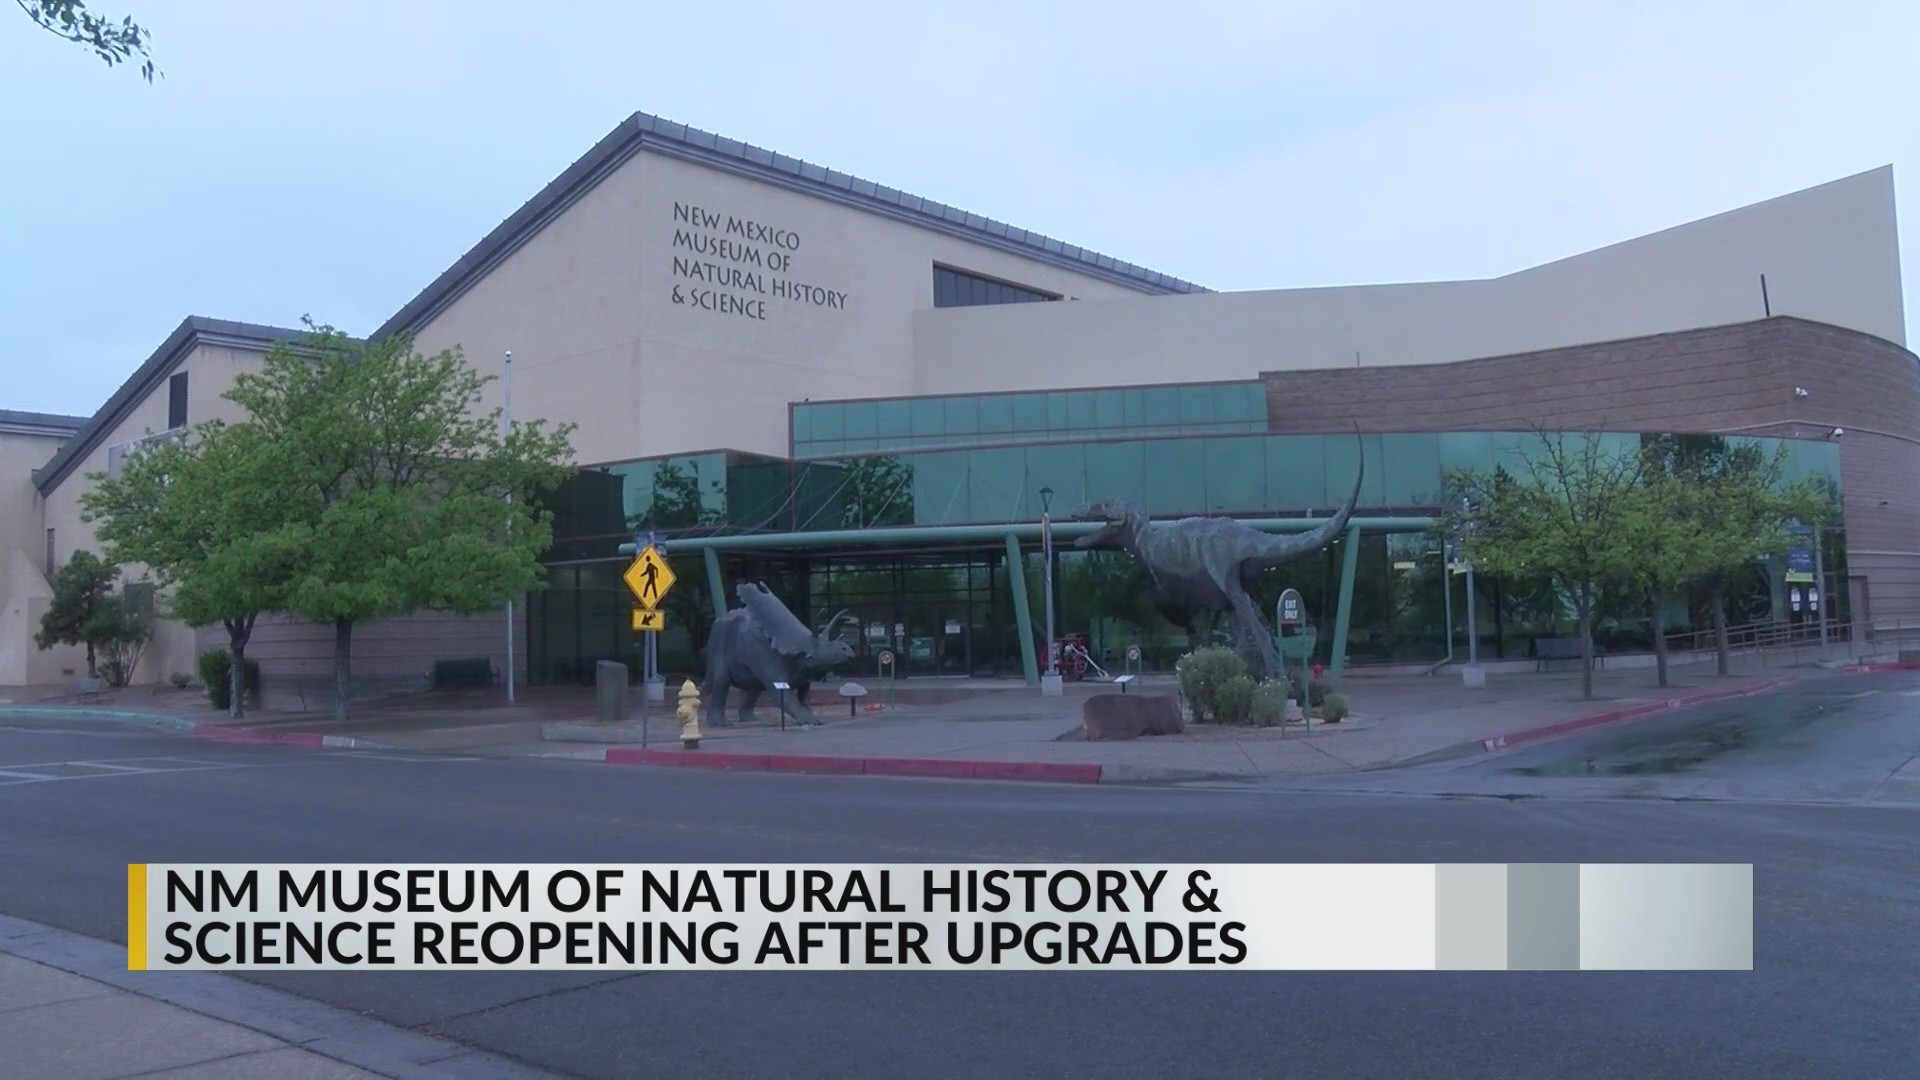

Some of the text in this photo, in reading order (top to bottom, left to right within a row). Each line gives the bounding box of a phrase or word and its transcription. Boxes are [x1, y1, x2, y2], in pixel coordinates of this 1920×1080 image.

[673, 201, 800, 251] NEW MEXICO
[672, 229, 791, 272] MUSEUM OF
[672, 284, 766, 320] & SCIENCE
[673, 256, 848, 310] NATURAL HISTORY
